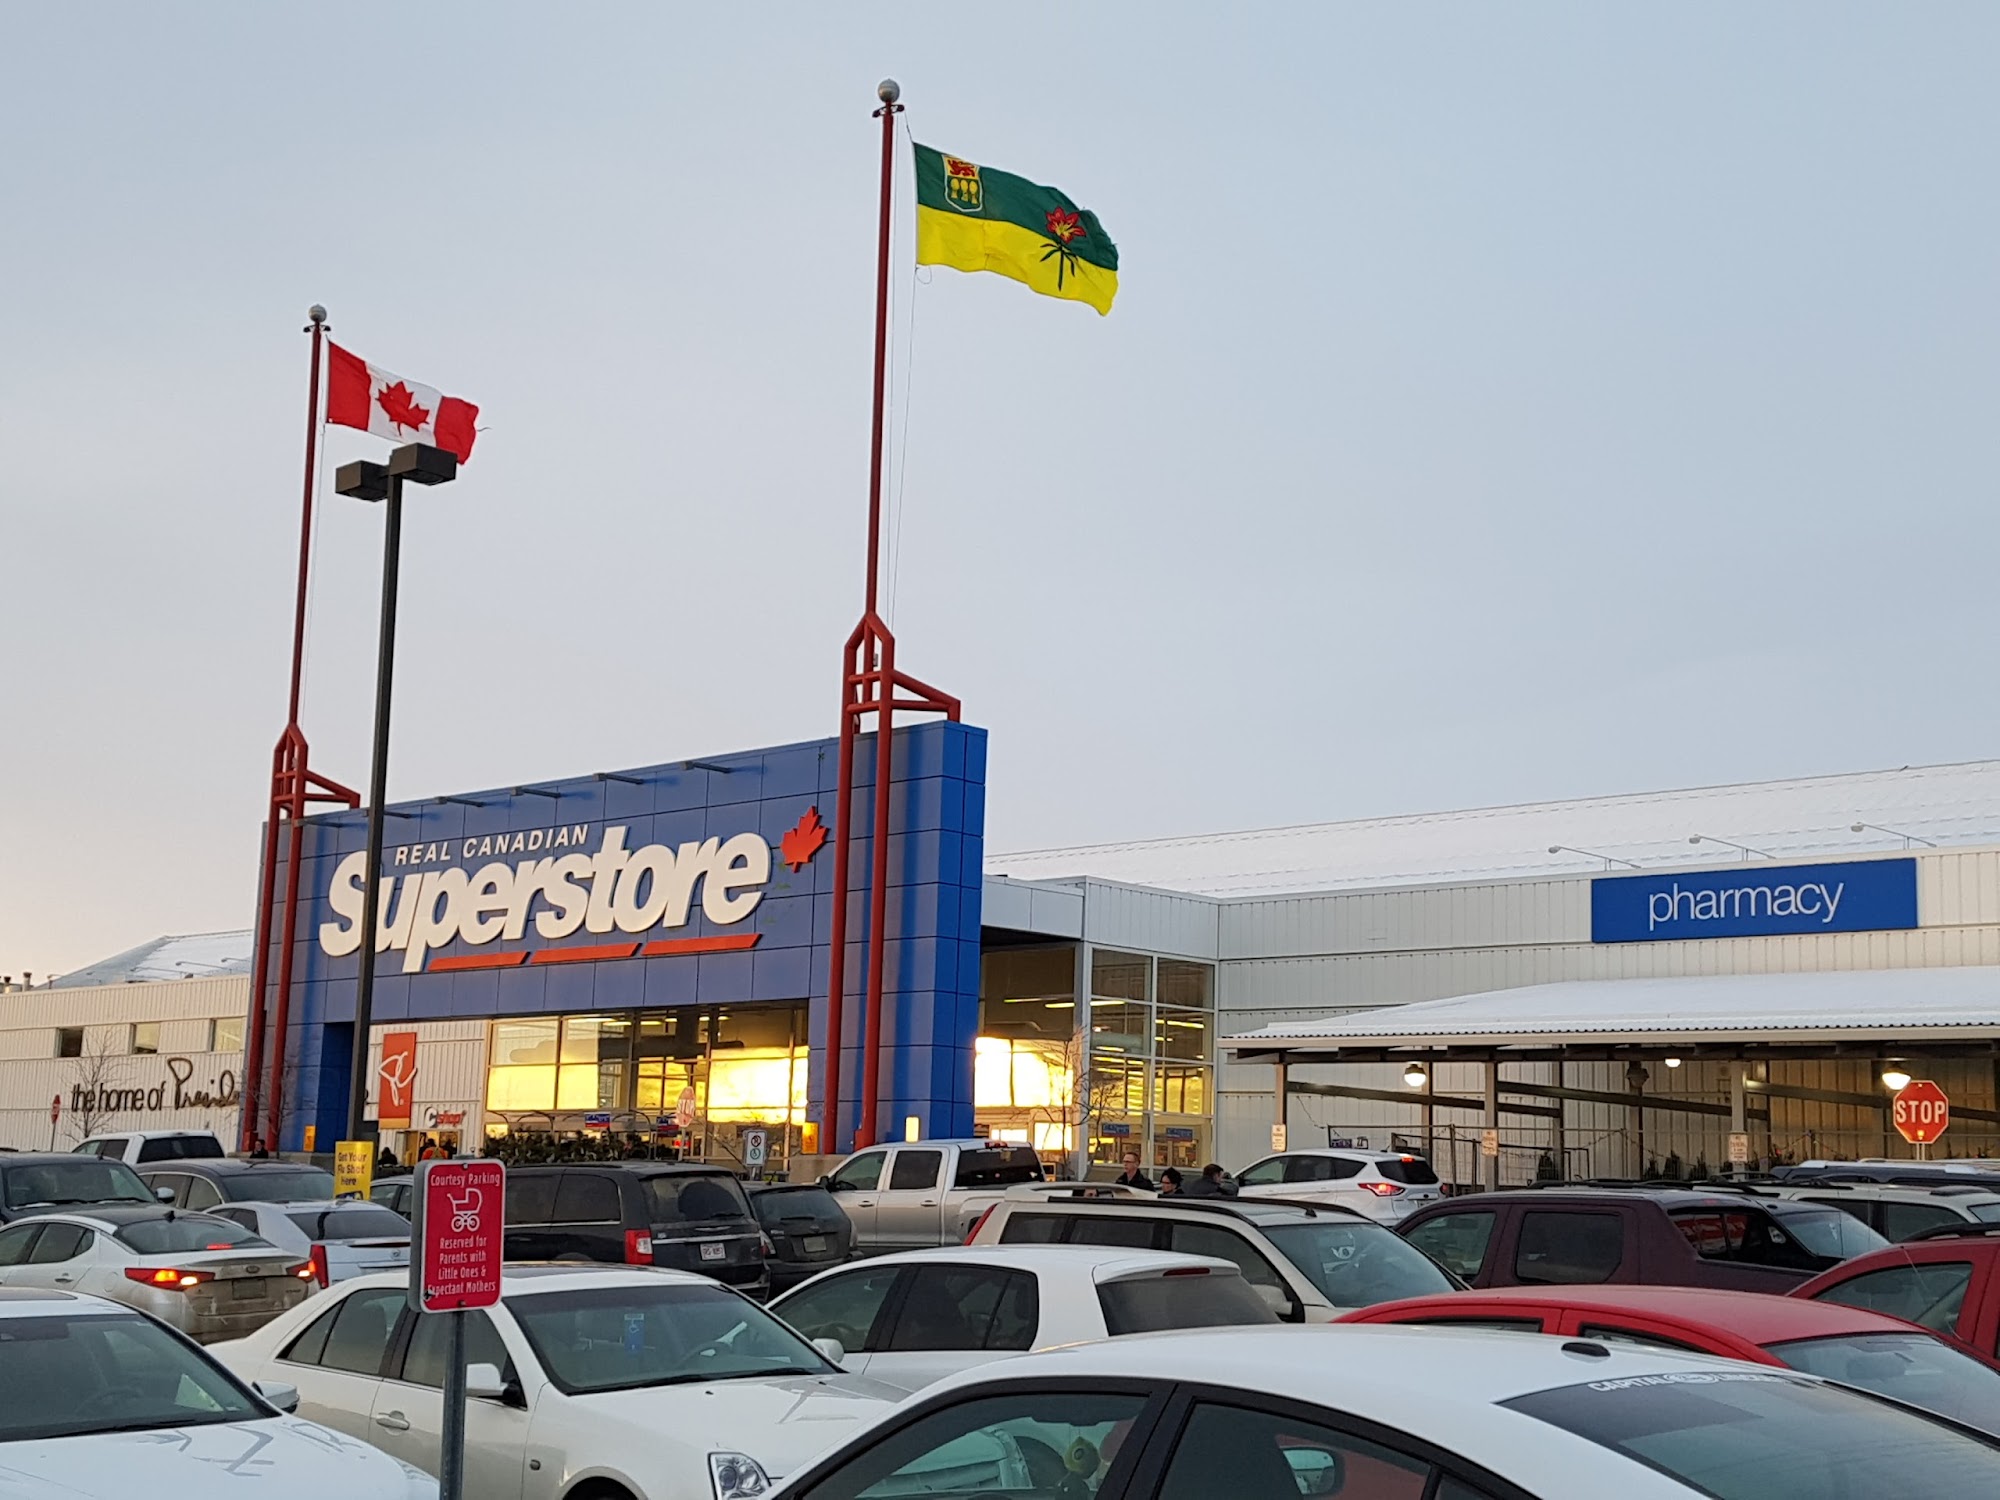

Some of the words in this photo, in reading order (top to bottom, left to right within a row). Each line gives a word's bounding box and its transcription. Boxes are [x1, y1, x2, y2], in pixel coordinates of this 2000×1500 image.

[394, 842, 451, 866] REAL
[462, 824, 588, 858] CANADIAN
[318, 825, 771, 972] Superstore
[1649, 882, 1844, 931] pharmacy
[71, 1083, 96, 1112] the
[98, 1083, 145, 1112] home
[147, 1080, 167, 1111] of
[1896, 1100, 1946, 1123] STOP
[349, 1152, 367, 1162] Your
[347, 1164, 365, 1174] Shot
[431, 1174, 465, 1188] Courtesy
[468, 1172, 500, 1187] Parking
[440, 1235, 474, 1249] Reserved
[476, 1235, 487, 1247] for
[440, 1252, 468, 1265] Parents
[470, 1250, 487, 1263] with
[438, 1267, 458, 1280] Little
[460, 1267, 479, 1279] Ones
[481, 1265, 487, 1277] &
[427, 1282, 464, 1298] Expectant
[466, 1281, 496, 1293] Mothers
